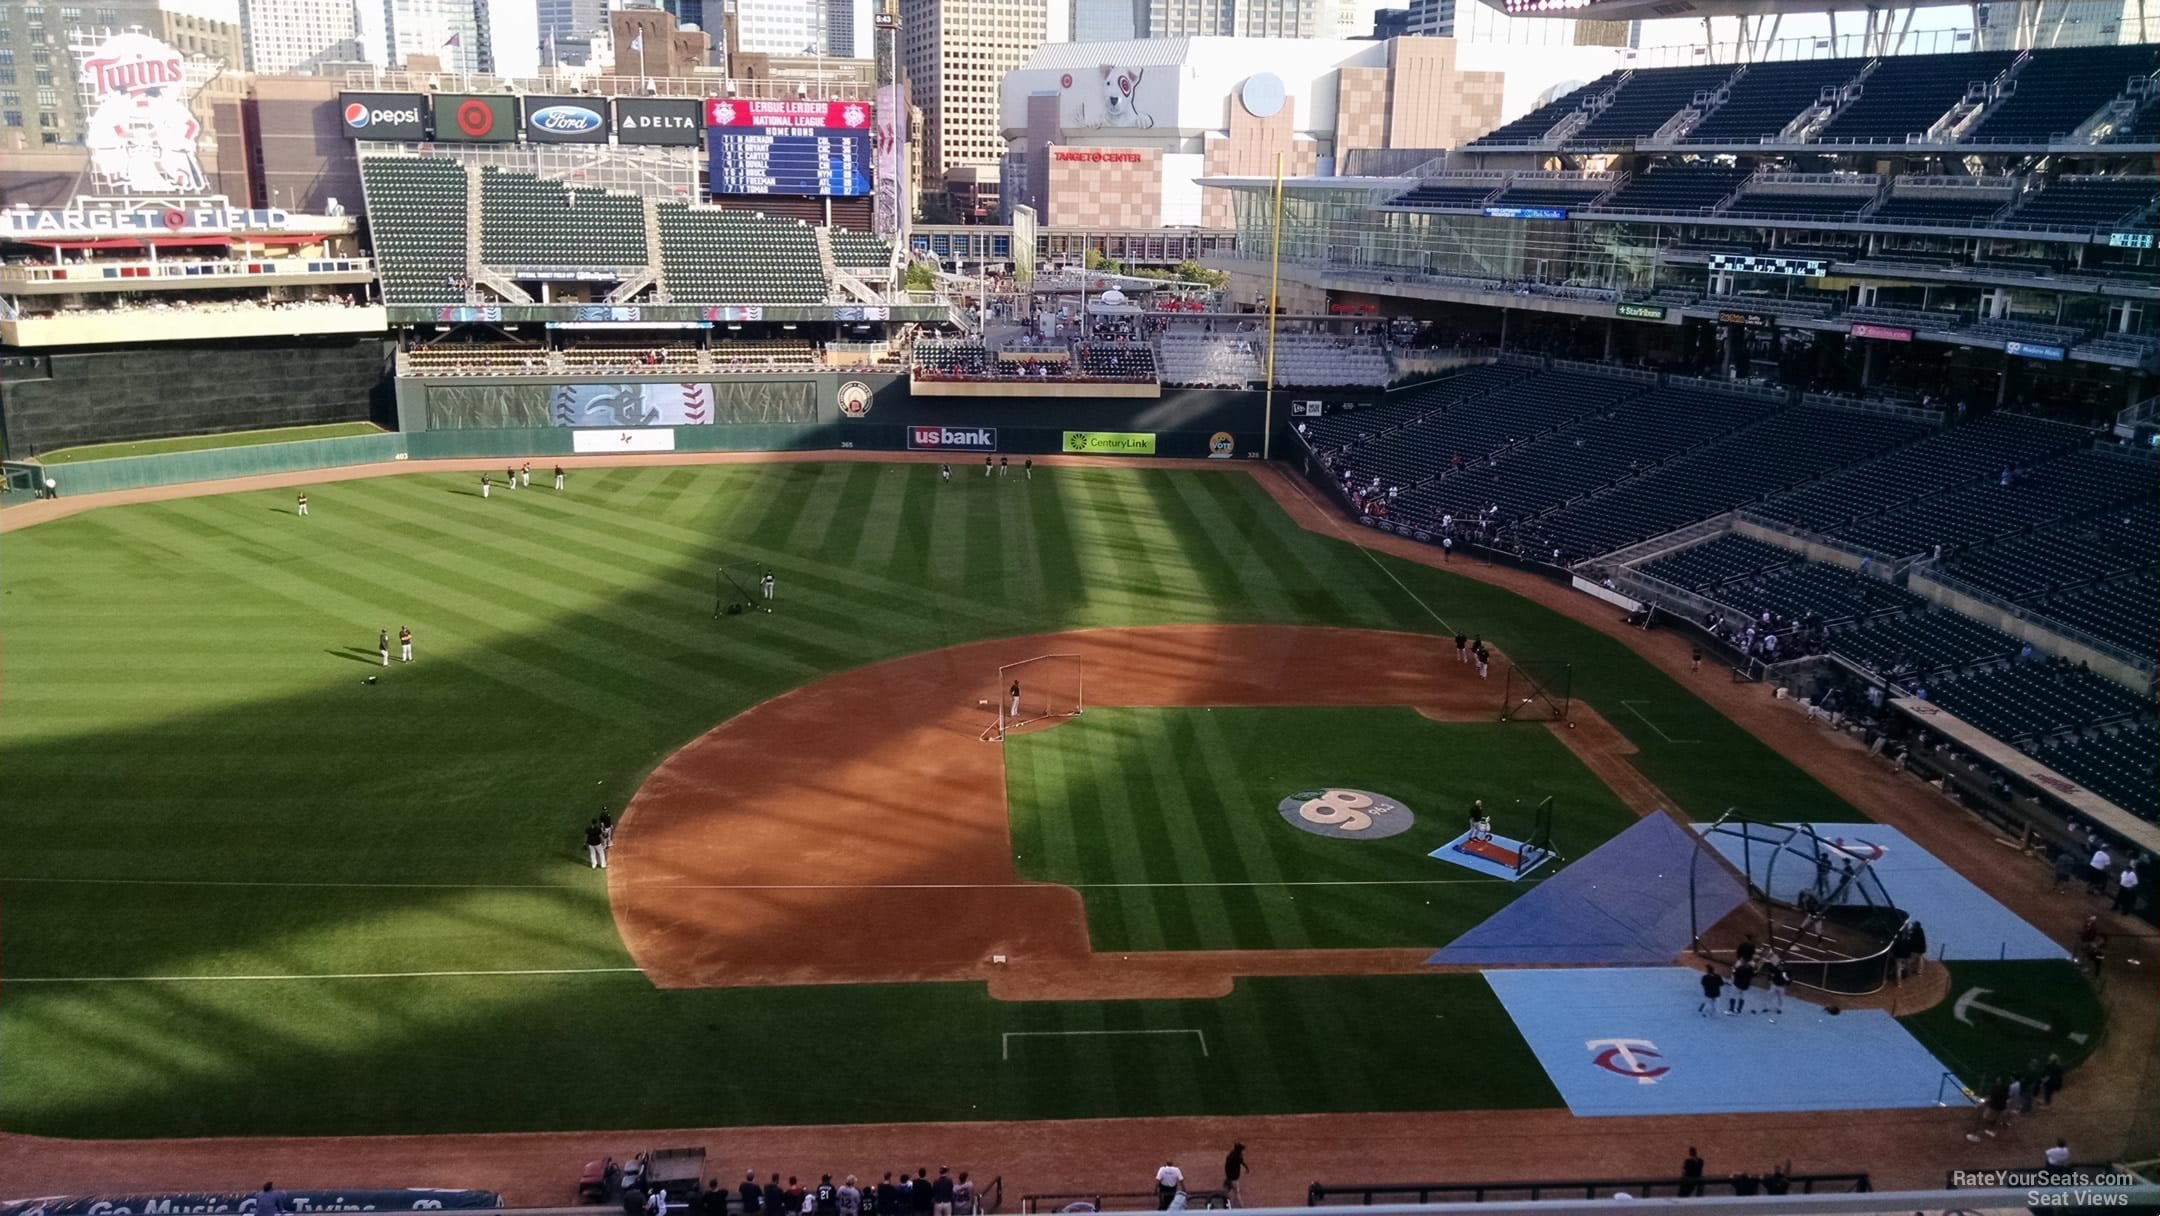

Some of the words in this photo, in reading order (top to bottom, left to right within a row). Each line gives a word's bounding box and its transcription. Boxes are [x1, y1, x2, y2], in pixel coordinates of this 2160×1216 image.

[84, 53, 183, 97] Twins
[749, 101, 785, 113] LEAGUE
[786, 101, 828, 114] LEADERS
[371, 107, 419, 125] pepsi
[545, 111, 587, 129] Ford
[640, 115, 694, 129] DELTA
[753, 115, 794, 126] NATIONAL
[794, 116, 826, 127] LEAGUE
[765, 127, 790, 136] HOME
[791, 127, 814, 137] RUNS
[1054, 152, 1091, 162] TARGET
[1102, 153, 1142, 163] CENTER
[11, 210, 158, 231] TARGET
[194, 208, 288, 230] FIELD
[915, 428, 993, 446] usbank
[1090, 437, 1148, 449] CenturyLink
